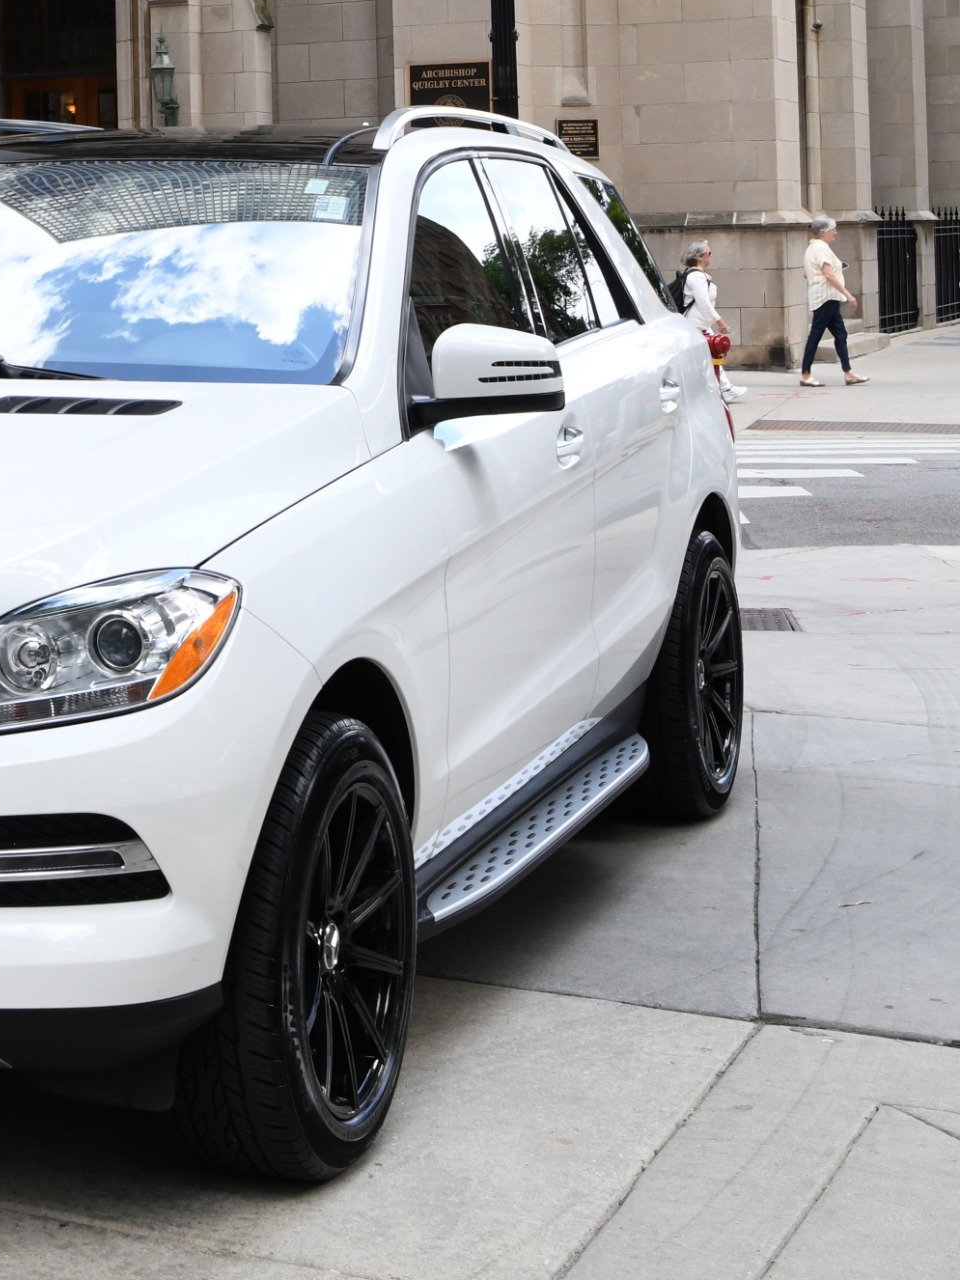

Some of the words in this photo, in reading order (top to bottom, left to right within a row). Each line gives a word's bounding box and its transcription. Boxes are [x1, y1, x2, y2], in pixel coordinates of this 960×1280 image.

[421, 68, 477, 78] ARCHBISHOP
[412, 80, 451, 90] QUIGLEY
[451, 78, 487, 88] CENTER
